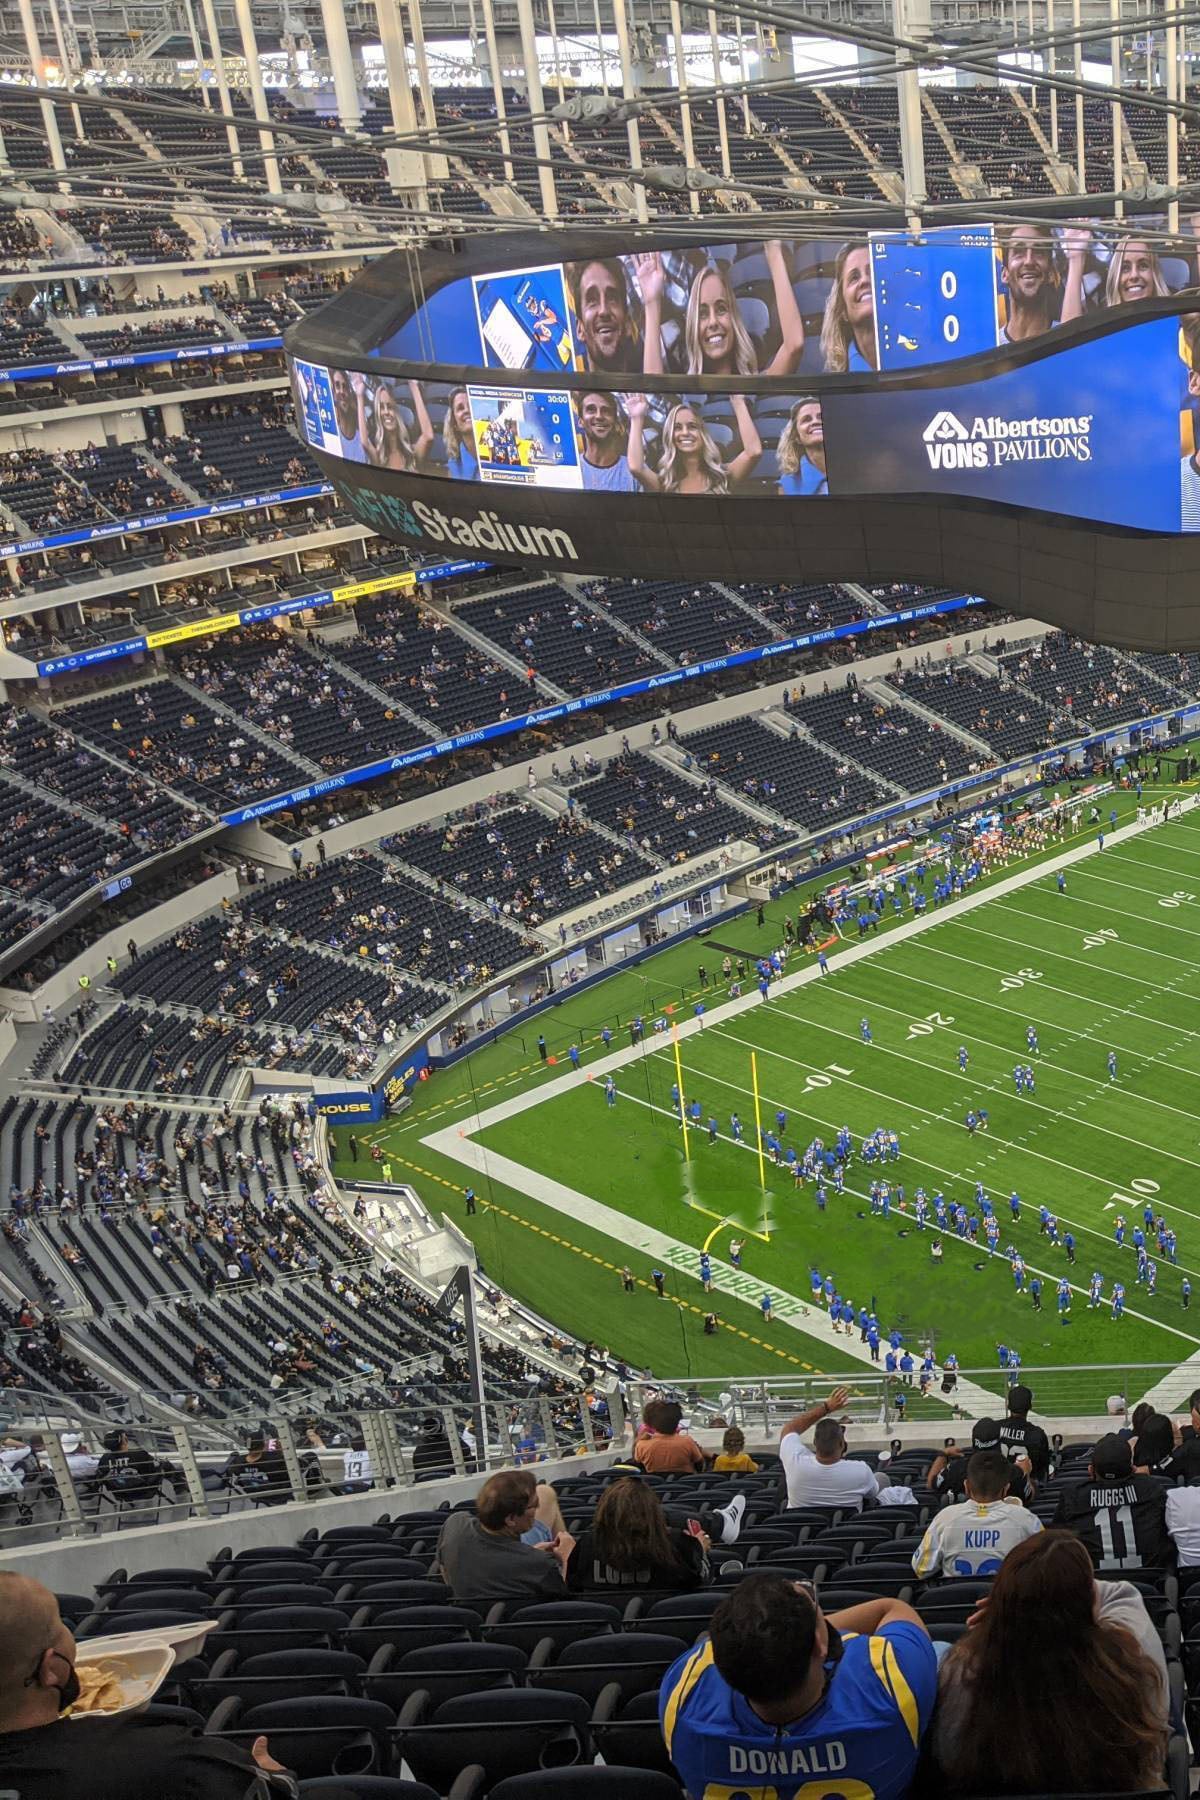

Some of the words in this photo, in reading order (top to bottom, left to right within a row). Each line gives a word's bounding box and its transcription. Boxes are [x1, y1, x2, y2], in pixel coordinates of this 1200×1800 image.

[941, 271, 957, 299] 0
[943, 315, 960, 342] 0
[548, 395, 567, 403] 30:00
[552, 414, 560, 424] 0
[971, 416, 1091, 439] Albertsons
[553, 434, 561, 443] 0
[926, 441, 988, 469] VONS
[993, 435, 1090, 466] PAVILIONS
[412, 500, 579, 560] Stadium
[685, 666, 700, 676] VONS
[567, 702, 582, 712] VONS
[402, 750, 432, 767] Albertsons
[436, 741, 452, 753] VONS
[456, 731, 485, 746] PAVILIONS
[255, 799, 288, 816] Albertsons
[292, 789, 311, 802] VONS
[314, 776, 345, 795] PAVILIONS
[1158, 891, 1197, 909] 50
[1083, 928, 1119, 947] 40
[1001, 967, 1043, 990] 30
[909, 1011, 955, 1037] 20
[806, 1062, 855, 1090] 10
[318, 1103, 371, 1114] HOUSE
[1110, 1178, 1161, 1209] 10
[348, 1462, 362, 1478] 13
[1090, 1487, 1125, 1508] RUGGS
[1125, 1485, 1138, 1504] III
[965, 1529, 1001, 1548] KUPP
[1094, 1505, 1143, 1569] 11
[728, 1741, 848, 1775] DONALD
